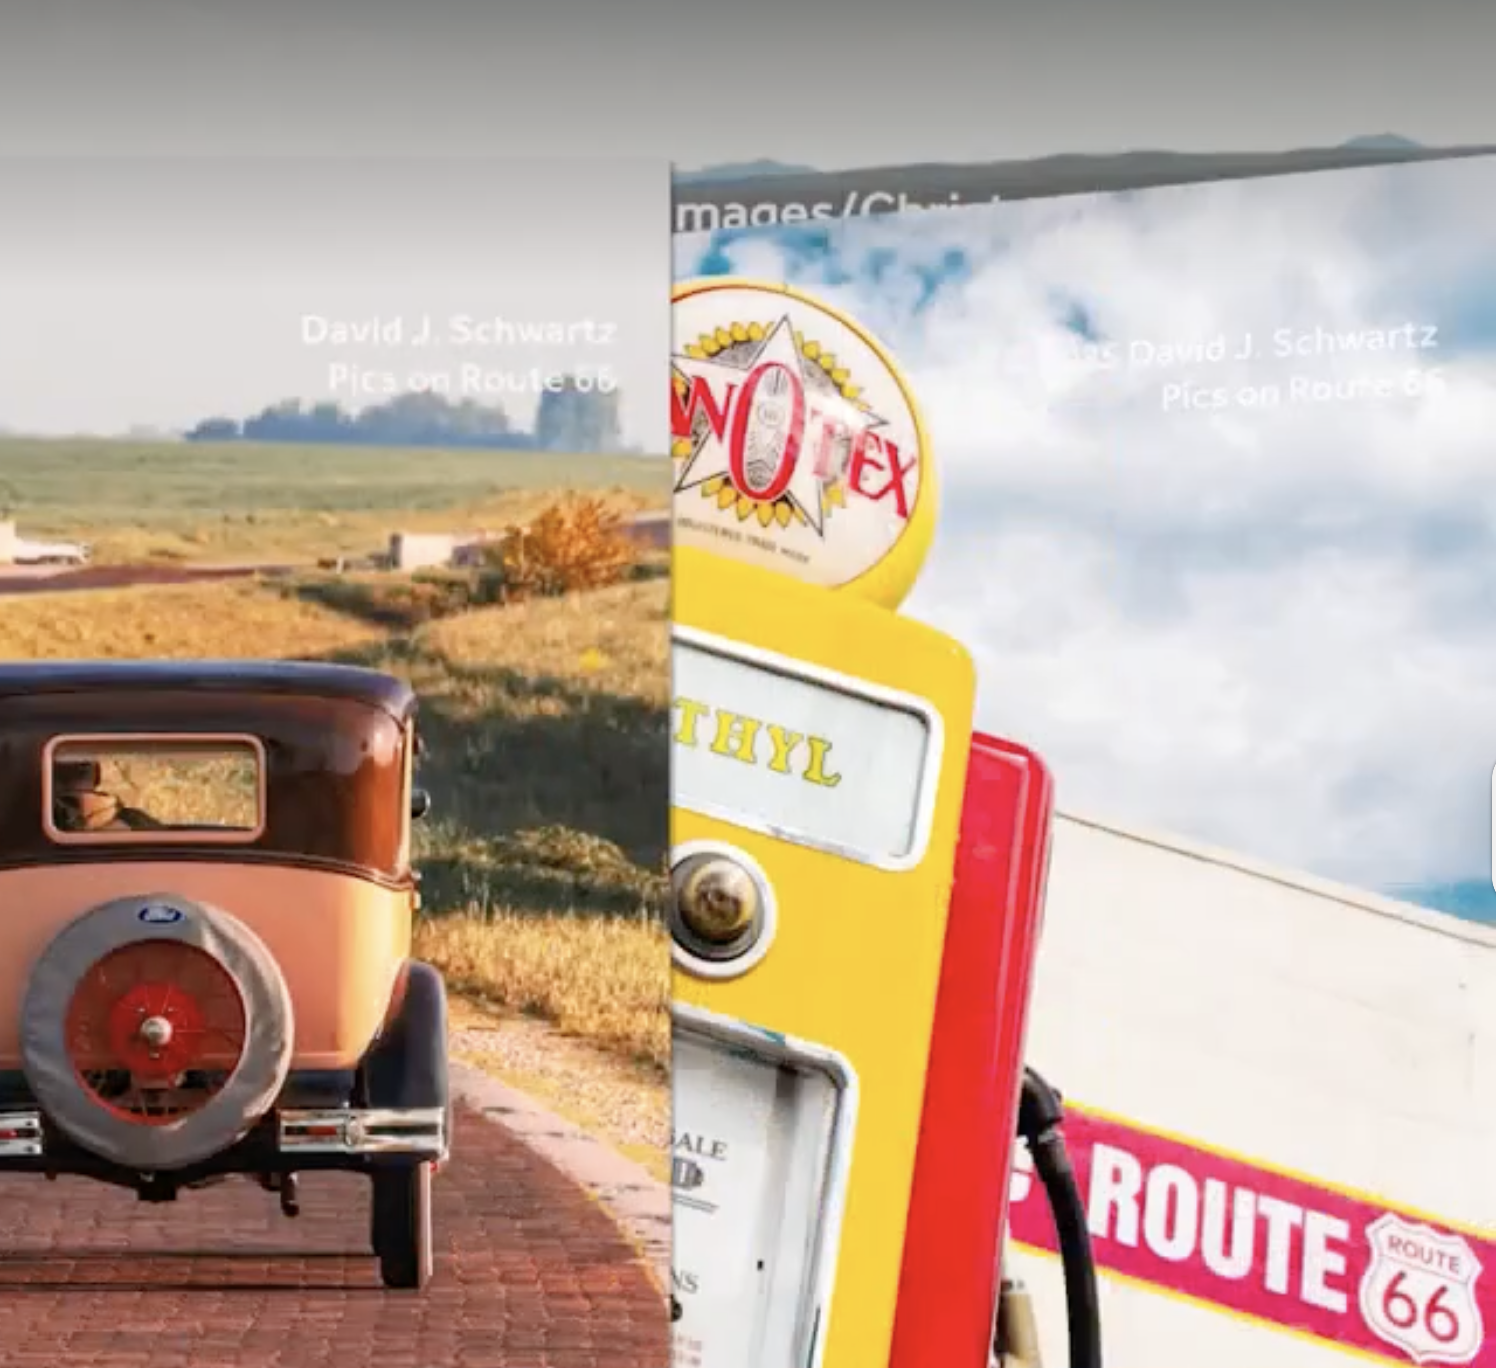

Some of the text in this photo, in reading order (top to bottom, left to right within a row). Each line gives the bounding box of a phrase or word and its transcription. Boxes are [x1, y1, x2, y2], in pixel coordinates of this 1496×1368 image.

[672, 697, 843, 787] THYL
[1087, 1142, 1351, 1314] ROUTE
[1386, 1234, 1461, 1276] ROUTE
[1382, 1270, 1460, 1343] 66
